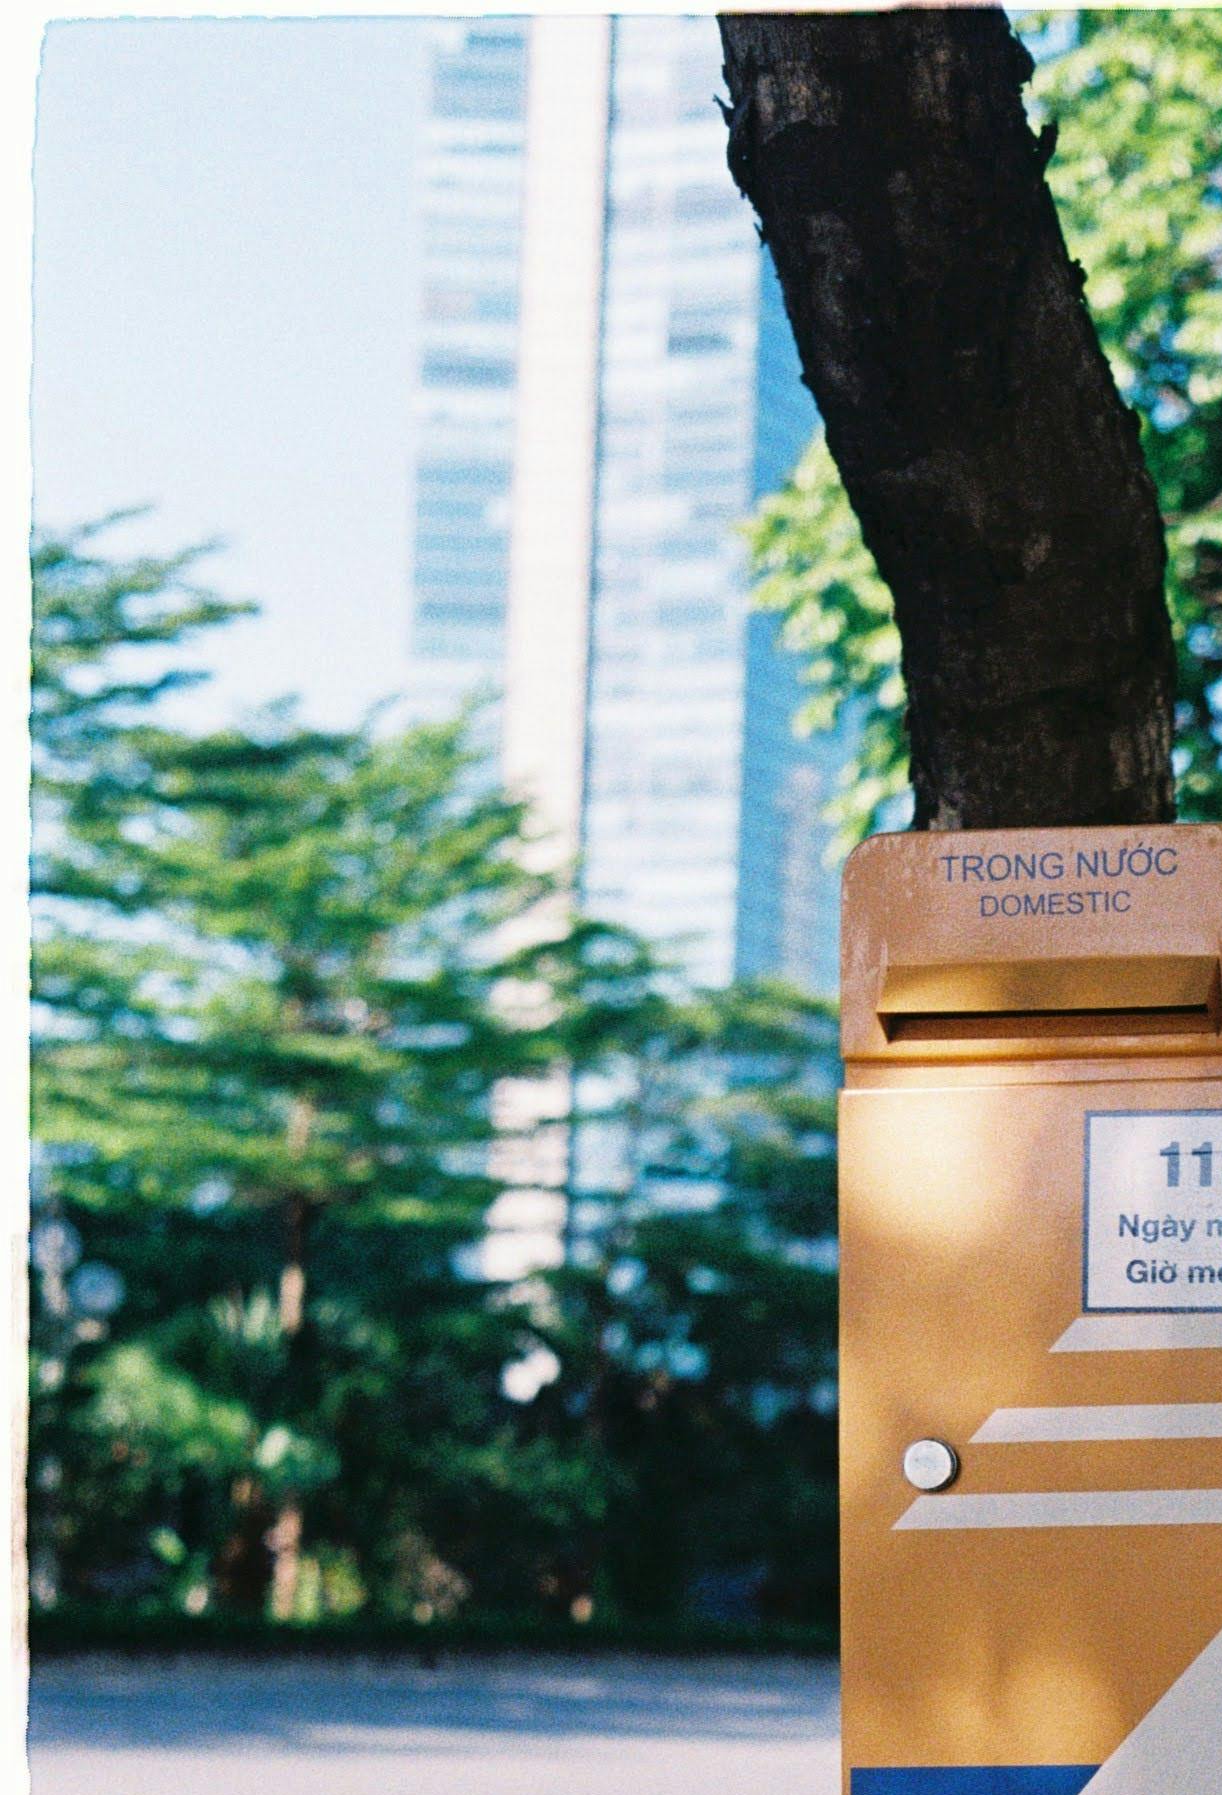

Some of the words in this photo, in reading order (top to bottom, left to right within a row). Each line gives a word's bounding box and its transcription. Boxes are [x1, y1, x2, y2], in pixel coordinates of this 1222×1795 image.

[942, 850, 1064, 884] TRONG
[1076, 842, 1179, 878] NƯỚC
[979, 889, 1132, 917] DOMESTIC
[1118, 1214, 1196, 1243] Ngày
[1126, 1258, 1178, 1284] Giờ
